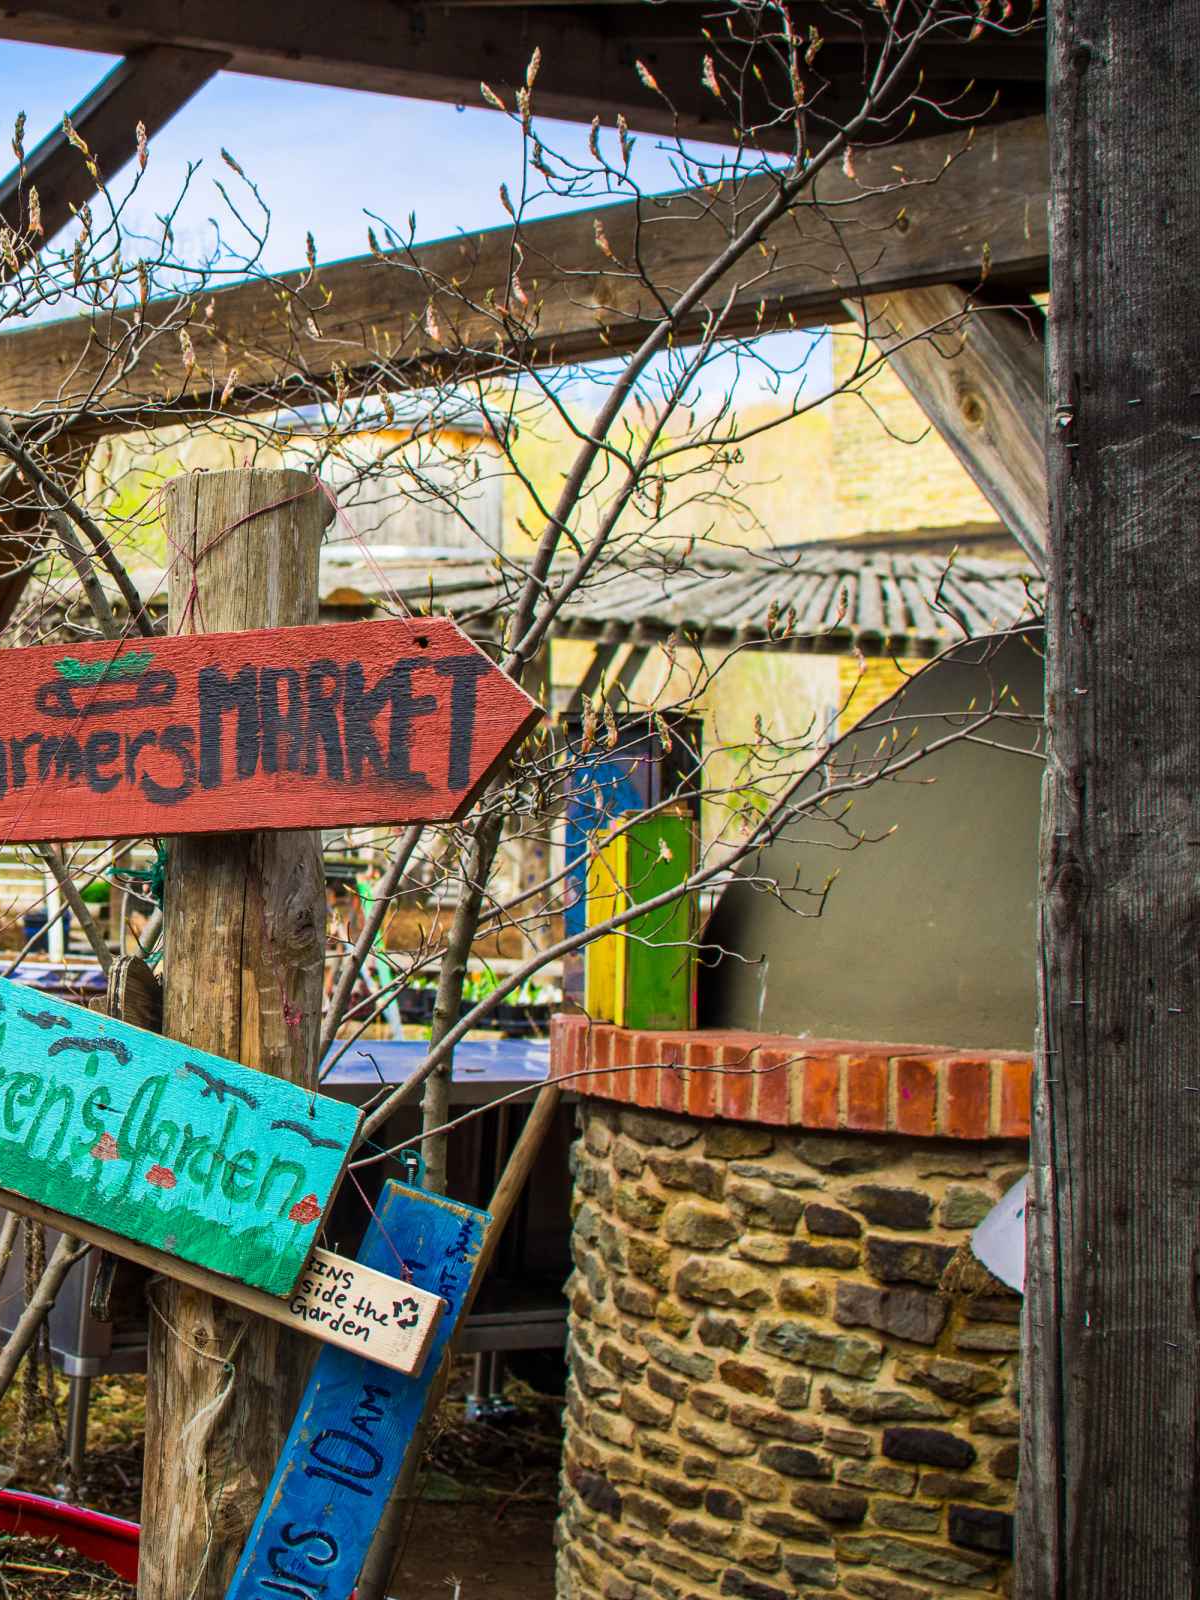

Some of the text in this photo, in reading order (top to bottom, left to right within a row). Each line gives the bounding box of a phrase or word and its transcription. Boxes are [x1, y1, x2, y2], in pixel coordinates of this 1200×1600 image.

[198, 654, 494, 796] MARKET
[288, 1295, 371, 1342] Garden
[352, 1296, 389, 1327] the
